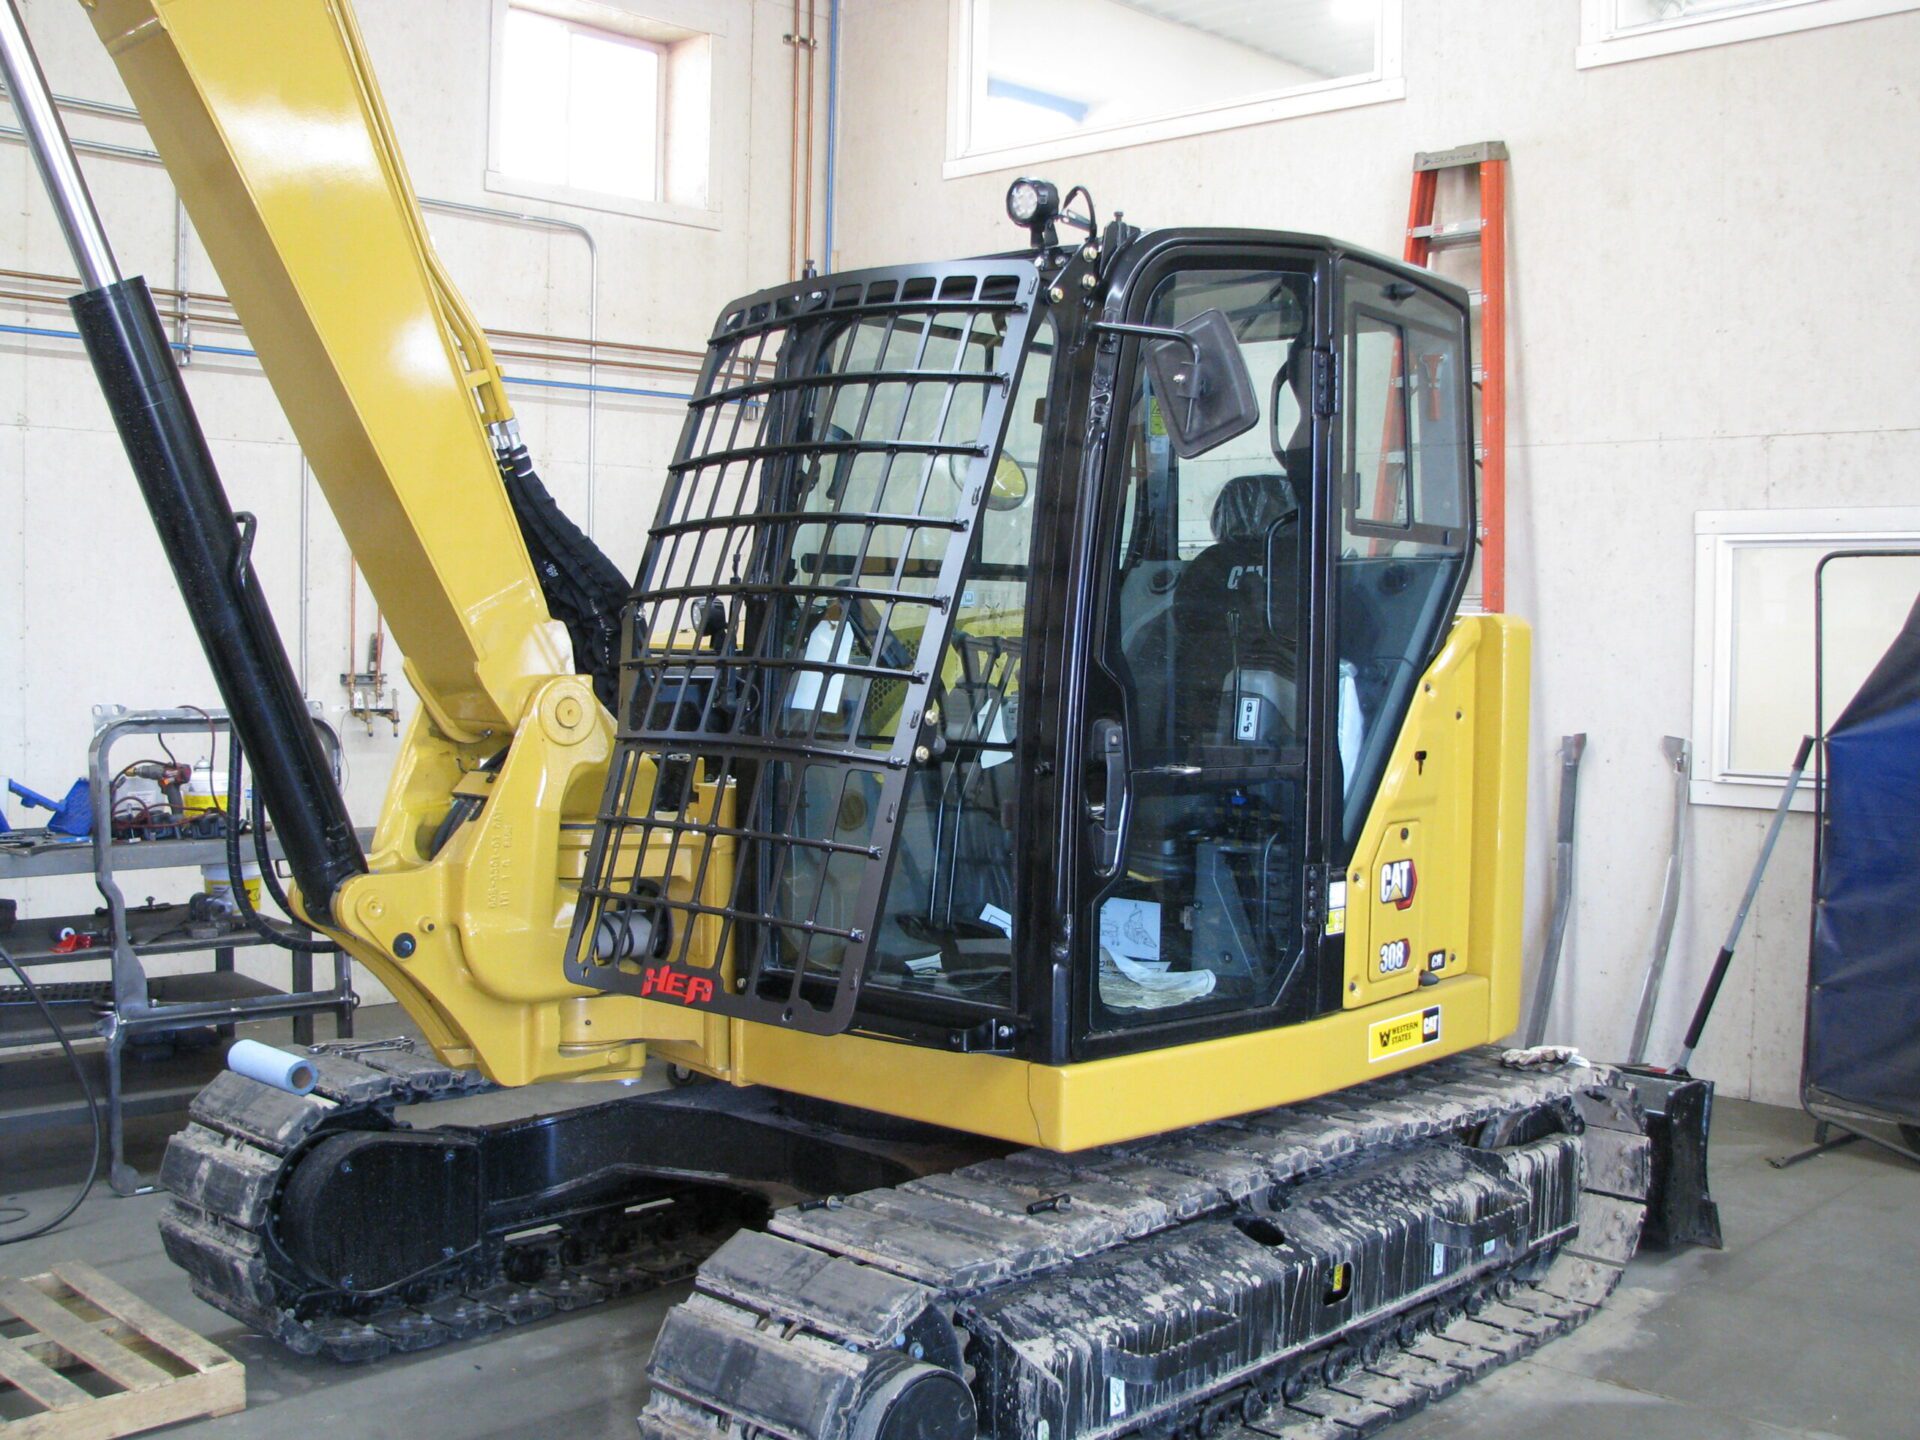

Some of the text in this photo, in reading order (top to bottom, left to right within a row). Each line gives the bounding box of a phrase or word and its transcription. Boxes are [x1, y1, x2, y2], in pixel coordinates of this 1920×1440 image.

[1381, 859, 1411, 903] CAT
[1380, 941, 1405, 974] 308
[1431, 953, 1443, 968] CR
[641, 965, 713, 1005] HEA
[1391, 1021, 1418, 1034] WESTERN
[1423, 1014, 1439, 1034] CAT
[1391, 1032, 1411, 1045] STATES
